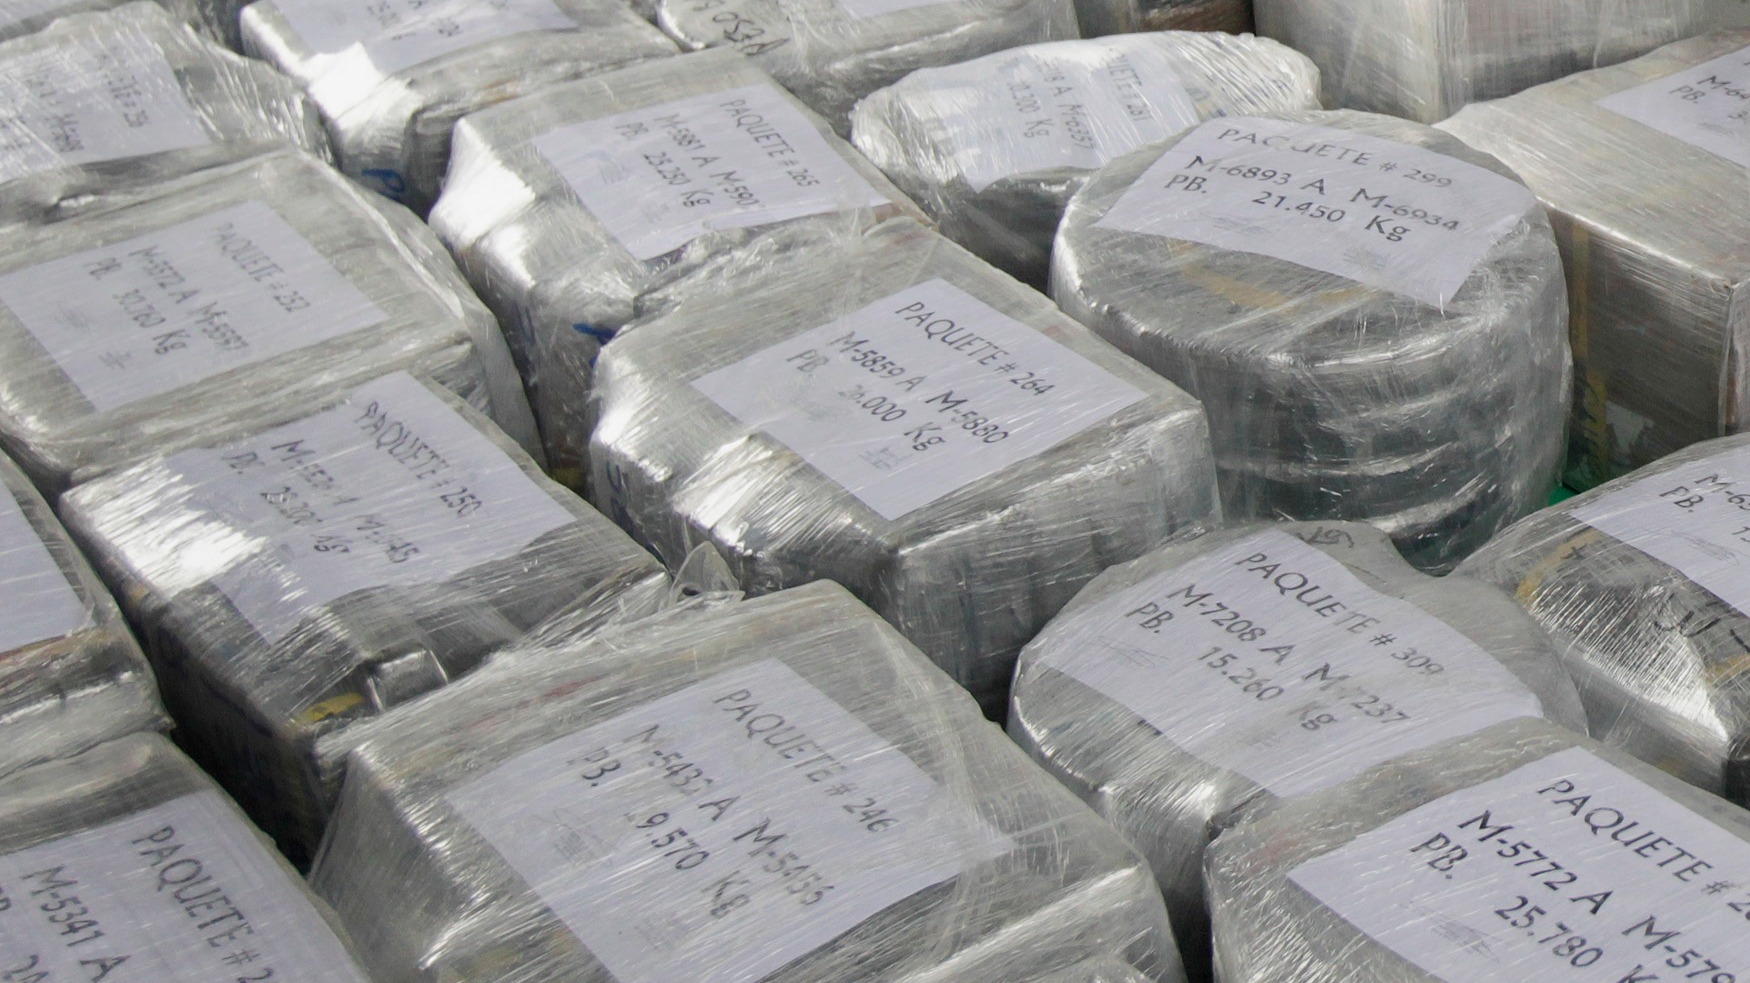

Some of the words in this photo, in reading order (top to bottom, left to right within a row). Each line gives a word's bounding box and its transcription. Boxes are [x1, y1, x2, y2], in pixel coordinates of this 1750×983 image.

[719, 98, 797, 158] PAQUETE
[786, 167, 820, 187] 265
[1023, 118, 1056, 139] Kg
[681, 190, 714, 209] Kg
[691, 155, 720, 168] A
[709, 169, 767, 209] M-590
[1164, 173, 1209, 195] PB.
[1252, 190, 1347, 224] 21.450
[1365, 215, 1412, 243] Kg
[1185, 155, 1292, 185] M-6893
[1301, 177, 1327, 196] A
[1349, 187, 1461, 233] M-6934
[1380, 160, 1399, 173] #
[1404, 167, 1453, 189] 299
[216, 221, 284, 282] PAQUETE
[168, 288, 200, 305] A
[152, 329, 192, 355] Kg
[895, 301, 1009, 365] PAQUETE
[996, 361, 1018, 375] #
[1010, 371, 1056, 397] 264
[830, 330, 905, 379] M-5859
[897, 374, 927, 392] A
[925, 389, 1011, 444] M-5880
[353, 401, 449, 480] PAQUETE
[438, 485, 484, 517] 250
[903, 421, 946, 452] Kg
[1658, 486, 1706, 515] PB.
[1126, 602, 1175, 635] PB.
[1197, 646, 1285, 703] 15.260
[1167, 583, 1269, 644] M-7208
[1258, 642, 1297, 664] A
[1234, 552, 1381, 635] PAQUETE
[1369, 630, 1398, 647] #
[1390, 645, 1445, 677] 309
[712, 688, 849, 783] PAQUETE
[623, 811, 711, 872] 9.570
[697, 793, 742, 822] A
[1535, 778, 1715, 884] PAQUETE
[131, 825, 255, 947] PAQUETE
[221, 948, 261, 966] #
[1410, 831, 1472, 880] PB.
[1492, 895, 1606, 969] 25.780
[1456, 809, 1579, 893] M-5772
[1567, 889, 1614, 916] A
[19, 865, 105, 947] M-5341
[79, 954, 132, 982] A
